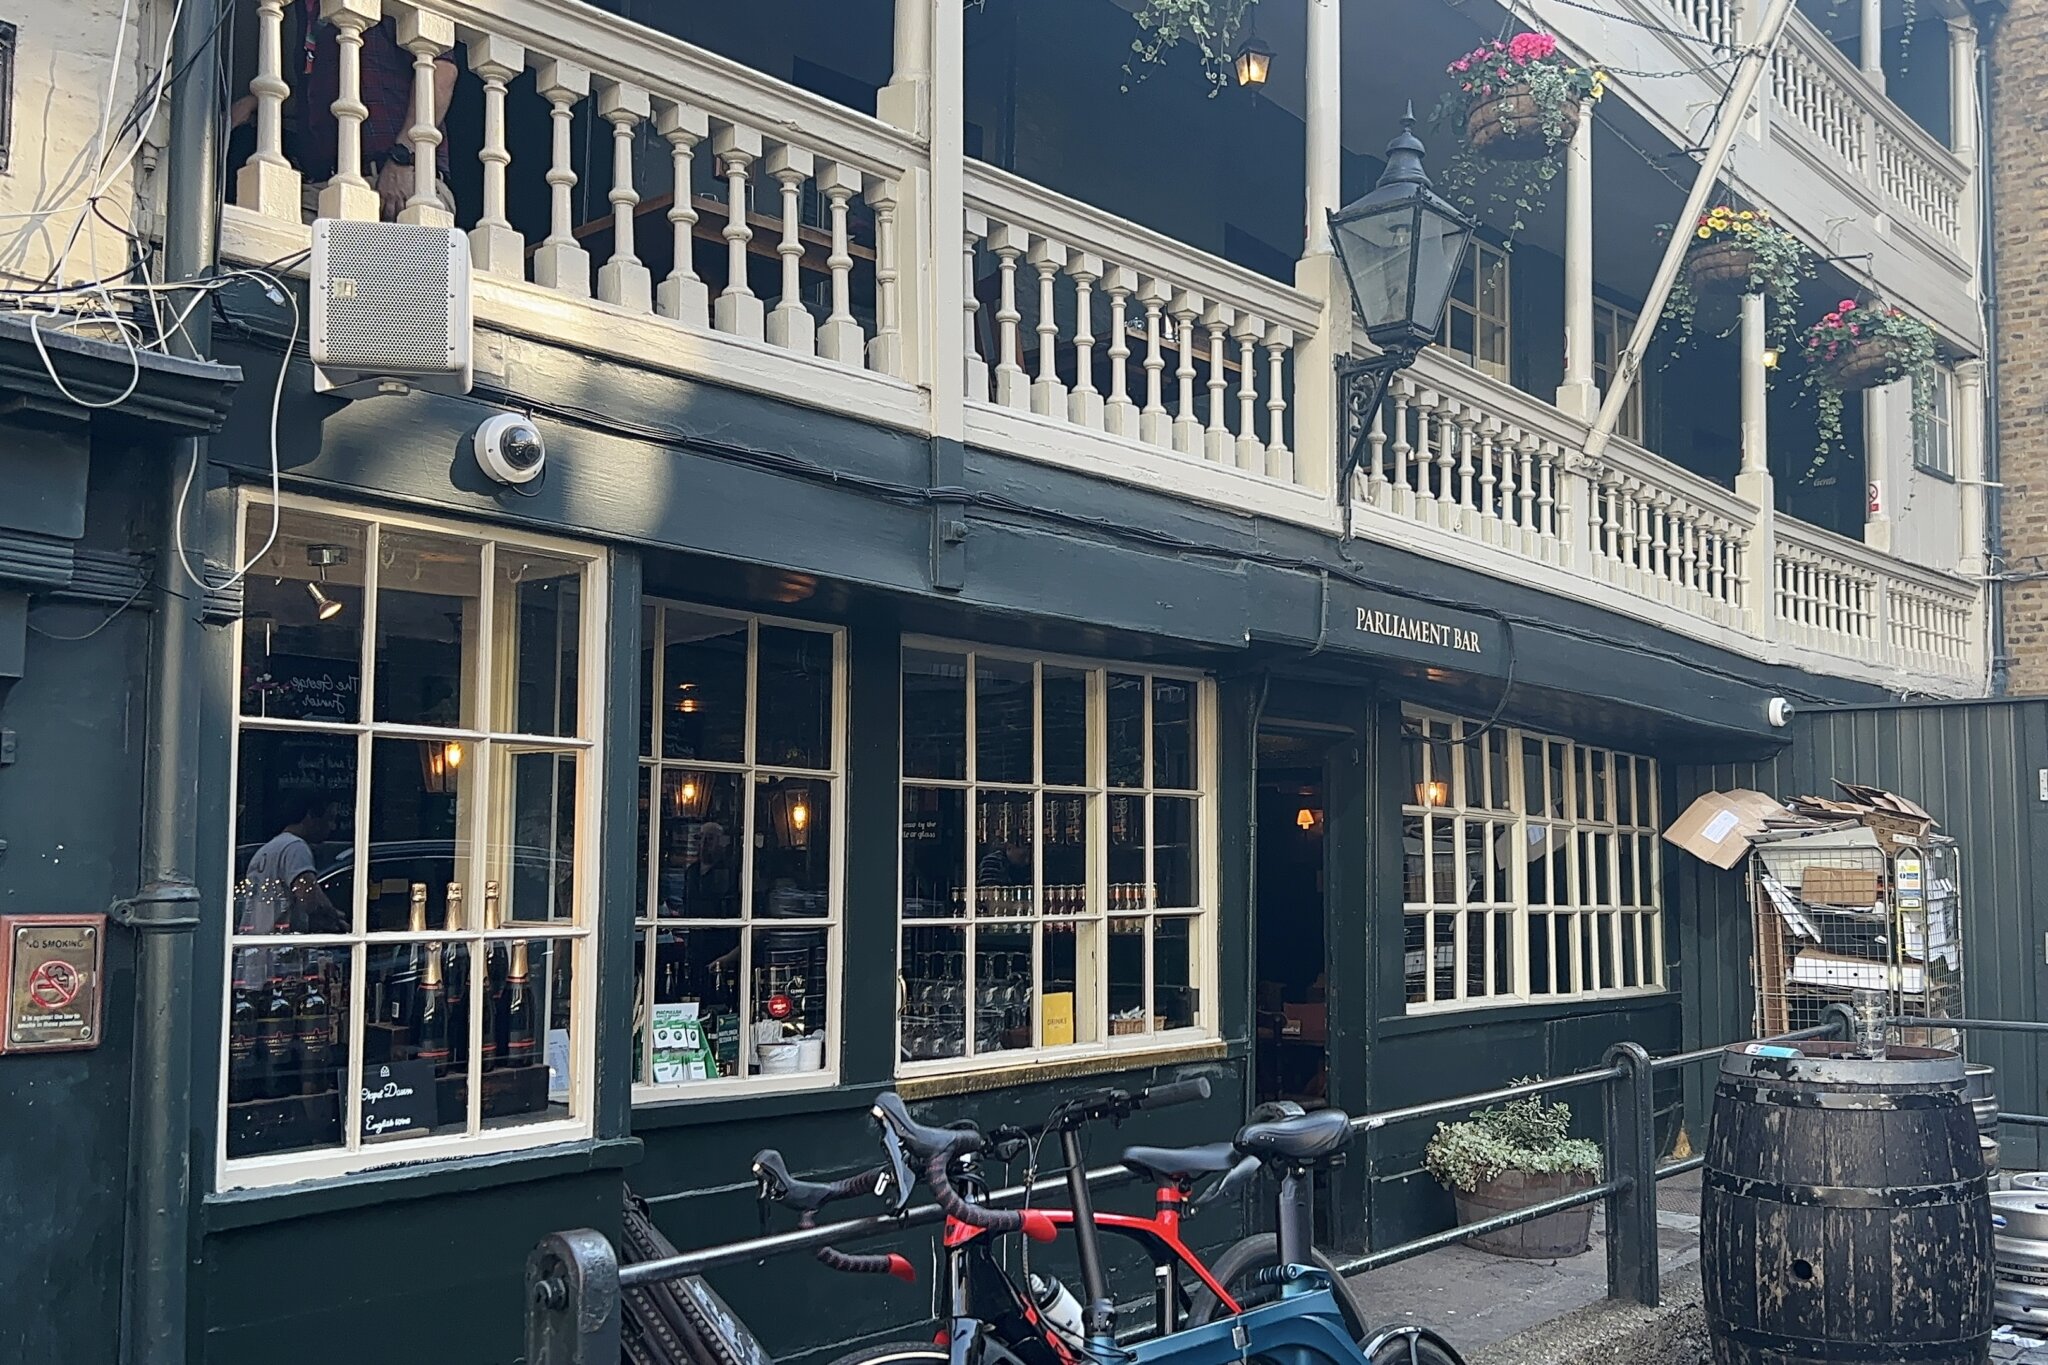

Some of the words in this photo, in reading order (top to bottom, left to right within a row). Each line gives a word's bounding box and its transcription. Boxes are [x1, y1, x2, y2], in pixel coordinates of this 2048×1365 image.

[1355, 606, 1451, 648] PARLIAMENT
[1453, 627, 1481, 653] BAR
[42, 939, 84, 949] SMOKING
